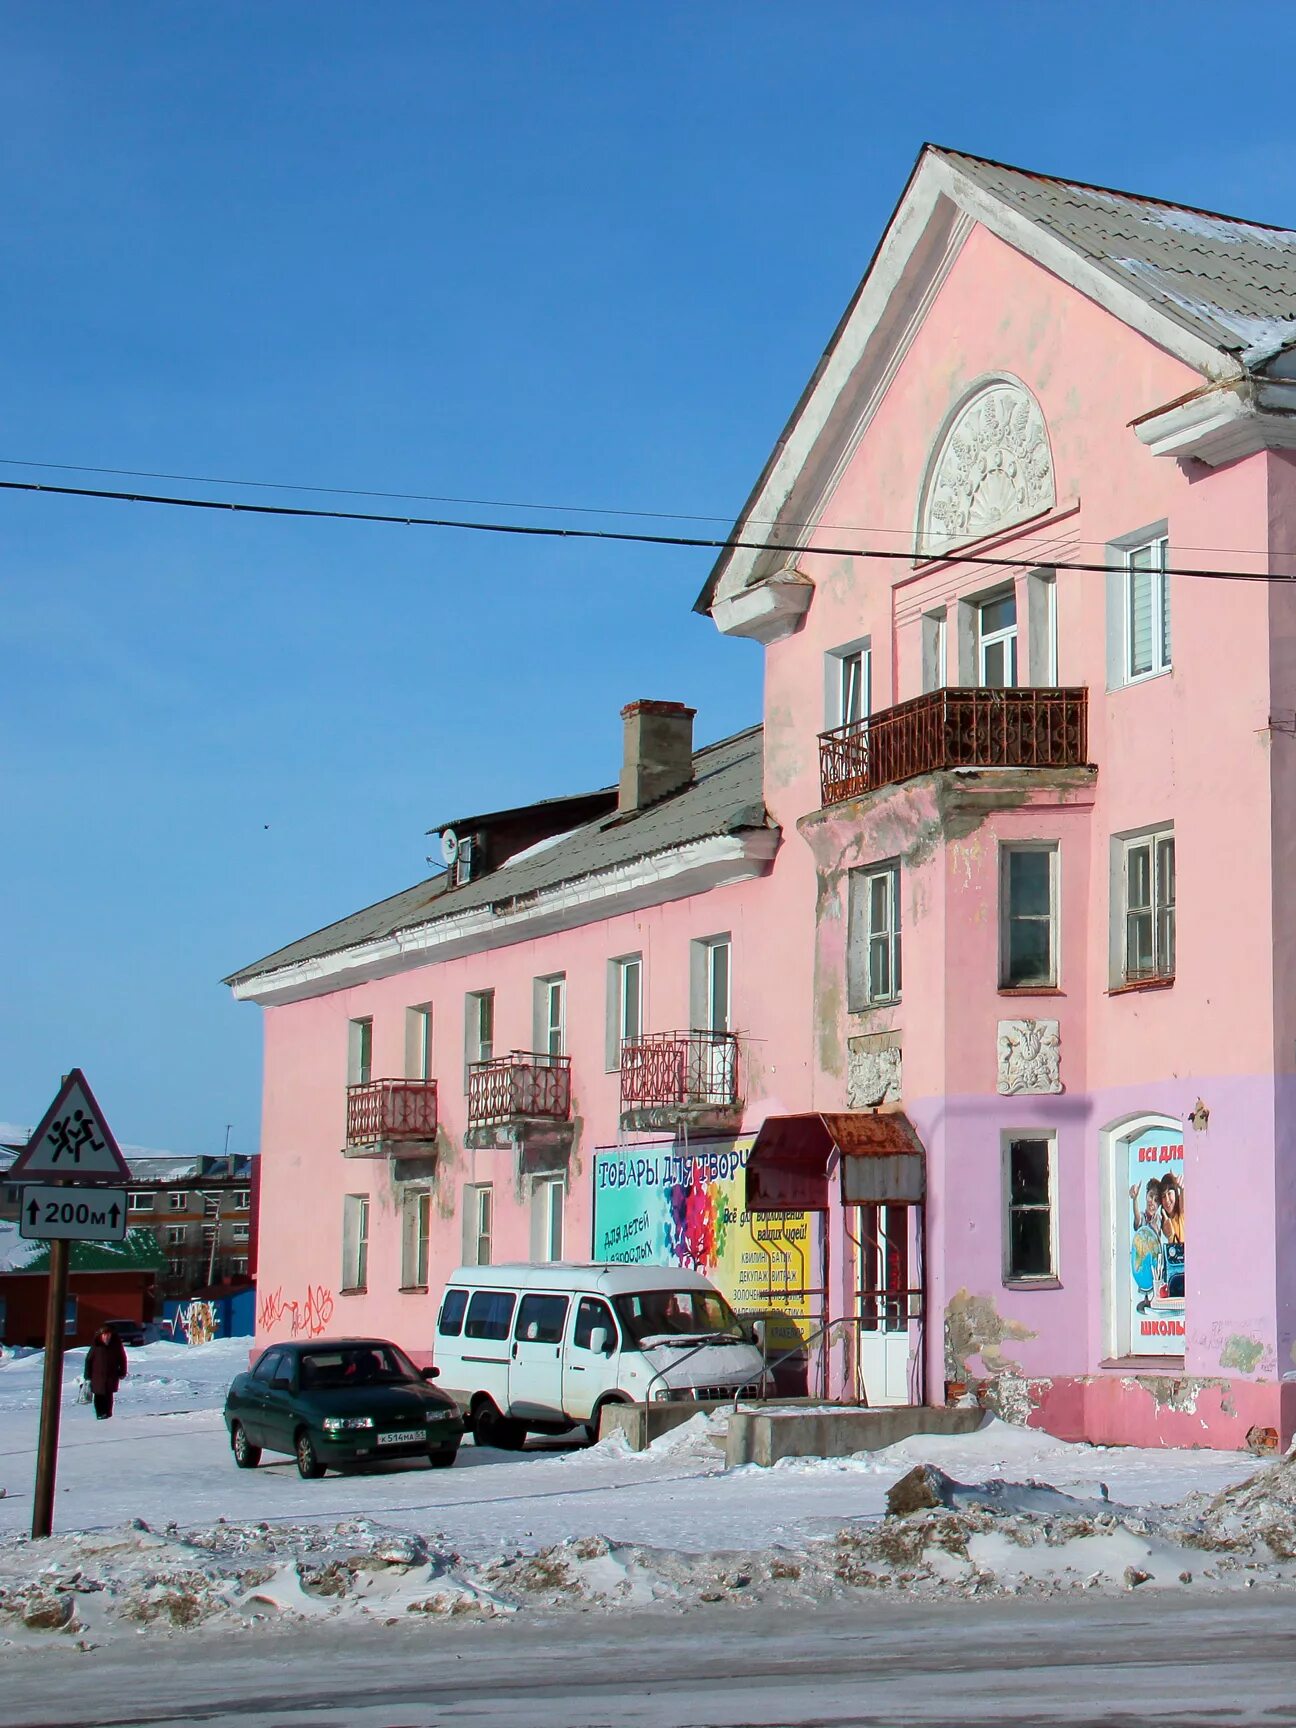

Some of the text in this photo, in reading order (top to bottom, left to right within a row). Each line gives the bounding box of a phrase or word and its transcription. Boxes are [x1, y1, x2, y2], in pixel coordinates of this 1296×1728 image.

[1139, 1145, 1184, 1163] ВСЕ ДЛЯ
[599, 1158, 659, 1188] ТОВАРЫ
[663, 1156, 693, 1186] ДЛЯ
[740, 1270, 769, 1282] ДЕКУПАЖ
